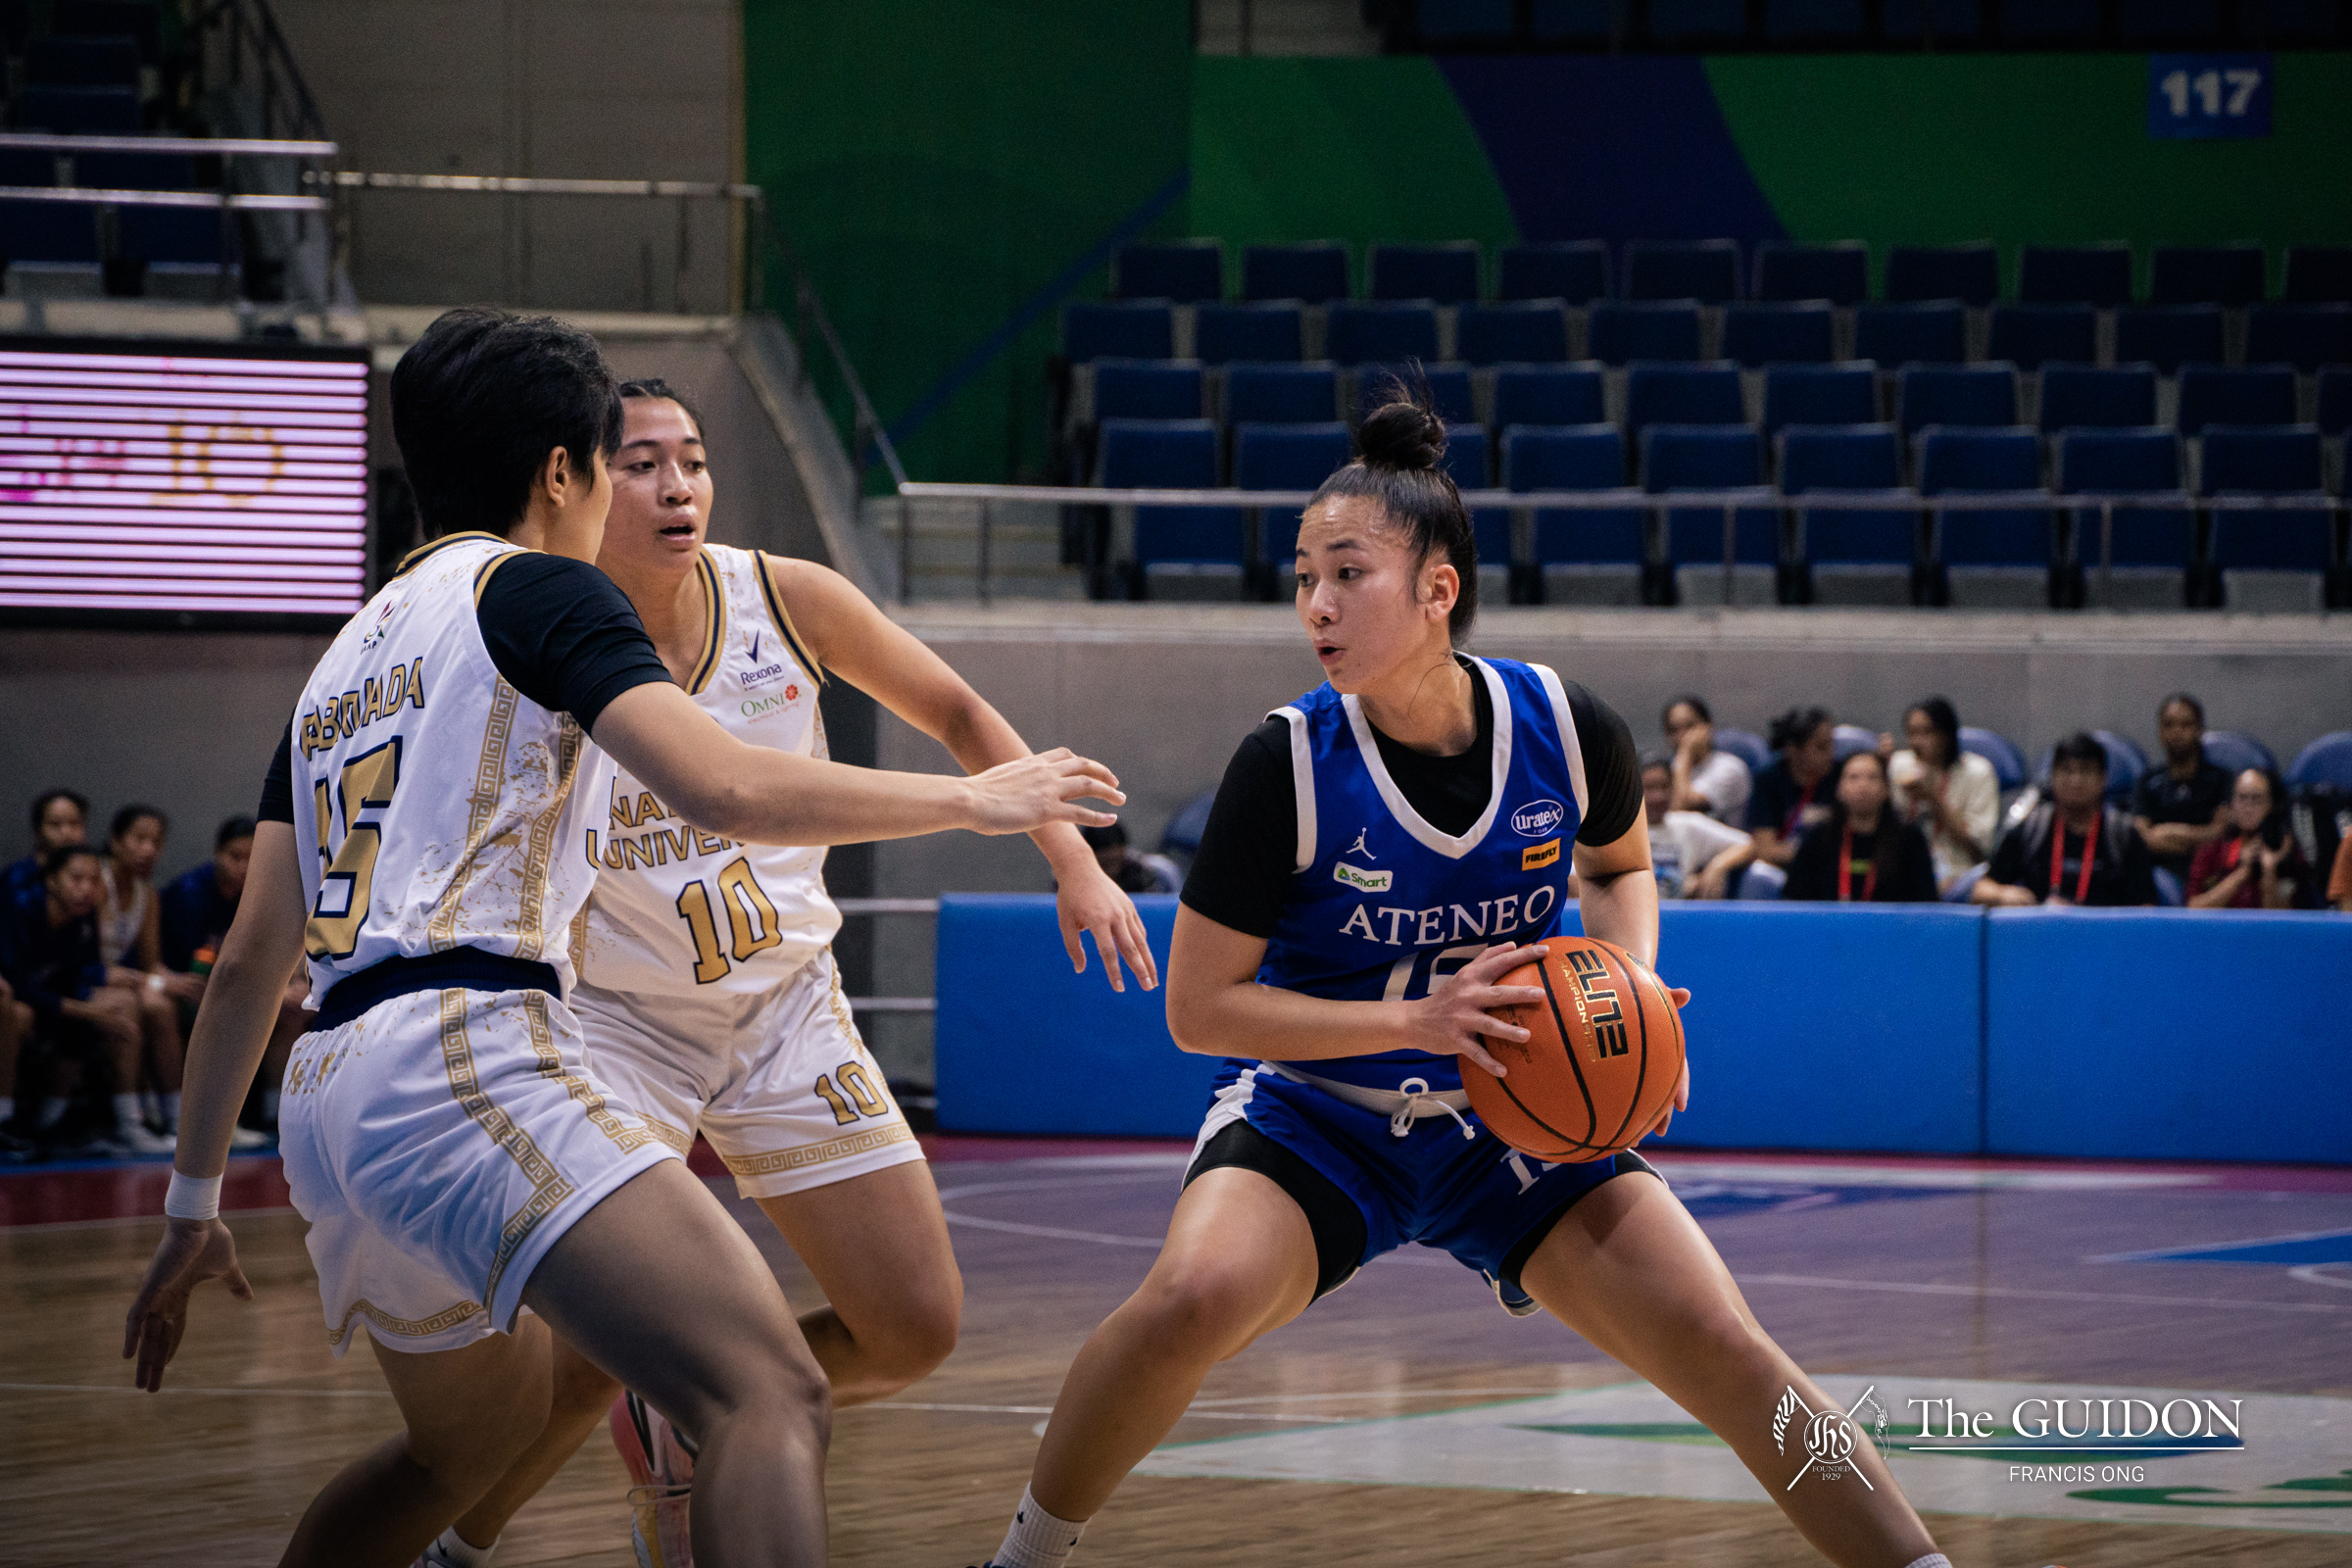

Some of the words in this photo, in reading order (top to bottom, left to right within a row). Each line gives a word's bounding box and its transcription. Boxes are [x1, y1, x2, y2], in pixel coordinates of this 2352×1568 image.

[2161, 69, 2262, 117] 117
[740, 663, 782, 685] Rexona
[1350, 872, 1387, 889] Smart
[1525, 846, 1558, 863] FIREFLY
[676, 857, 782, 984] 10
[1339, 885, 1556, 947] ATENEO
[1555, 958, 1597, 1063] HAMPIONSHIP
[1565, 949, 1629, 1059] ELITE
[813, 1059, 889, 1127] 10
